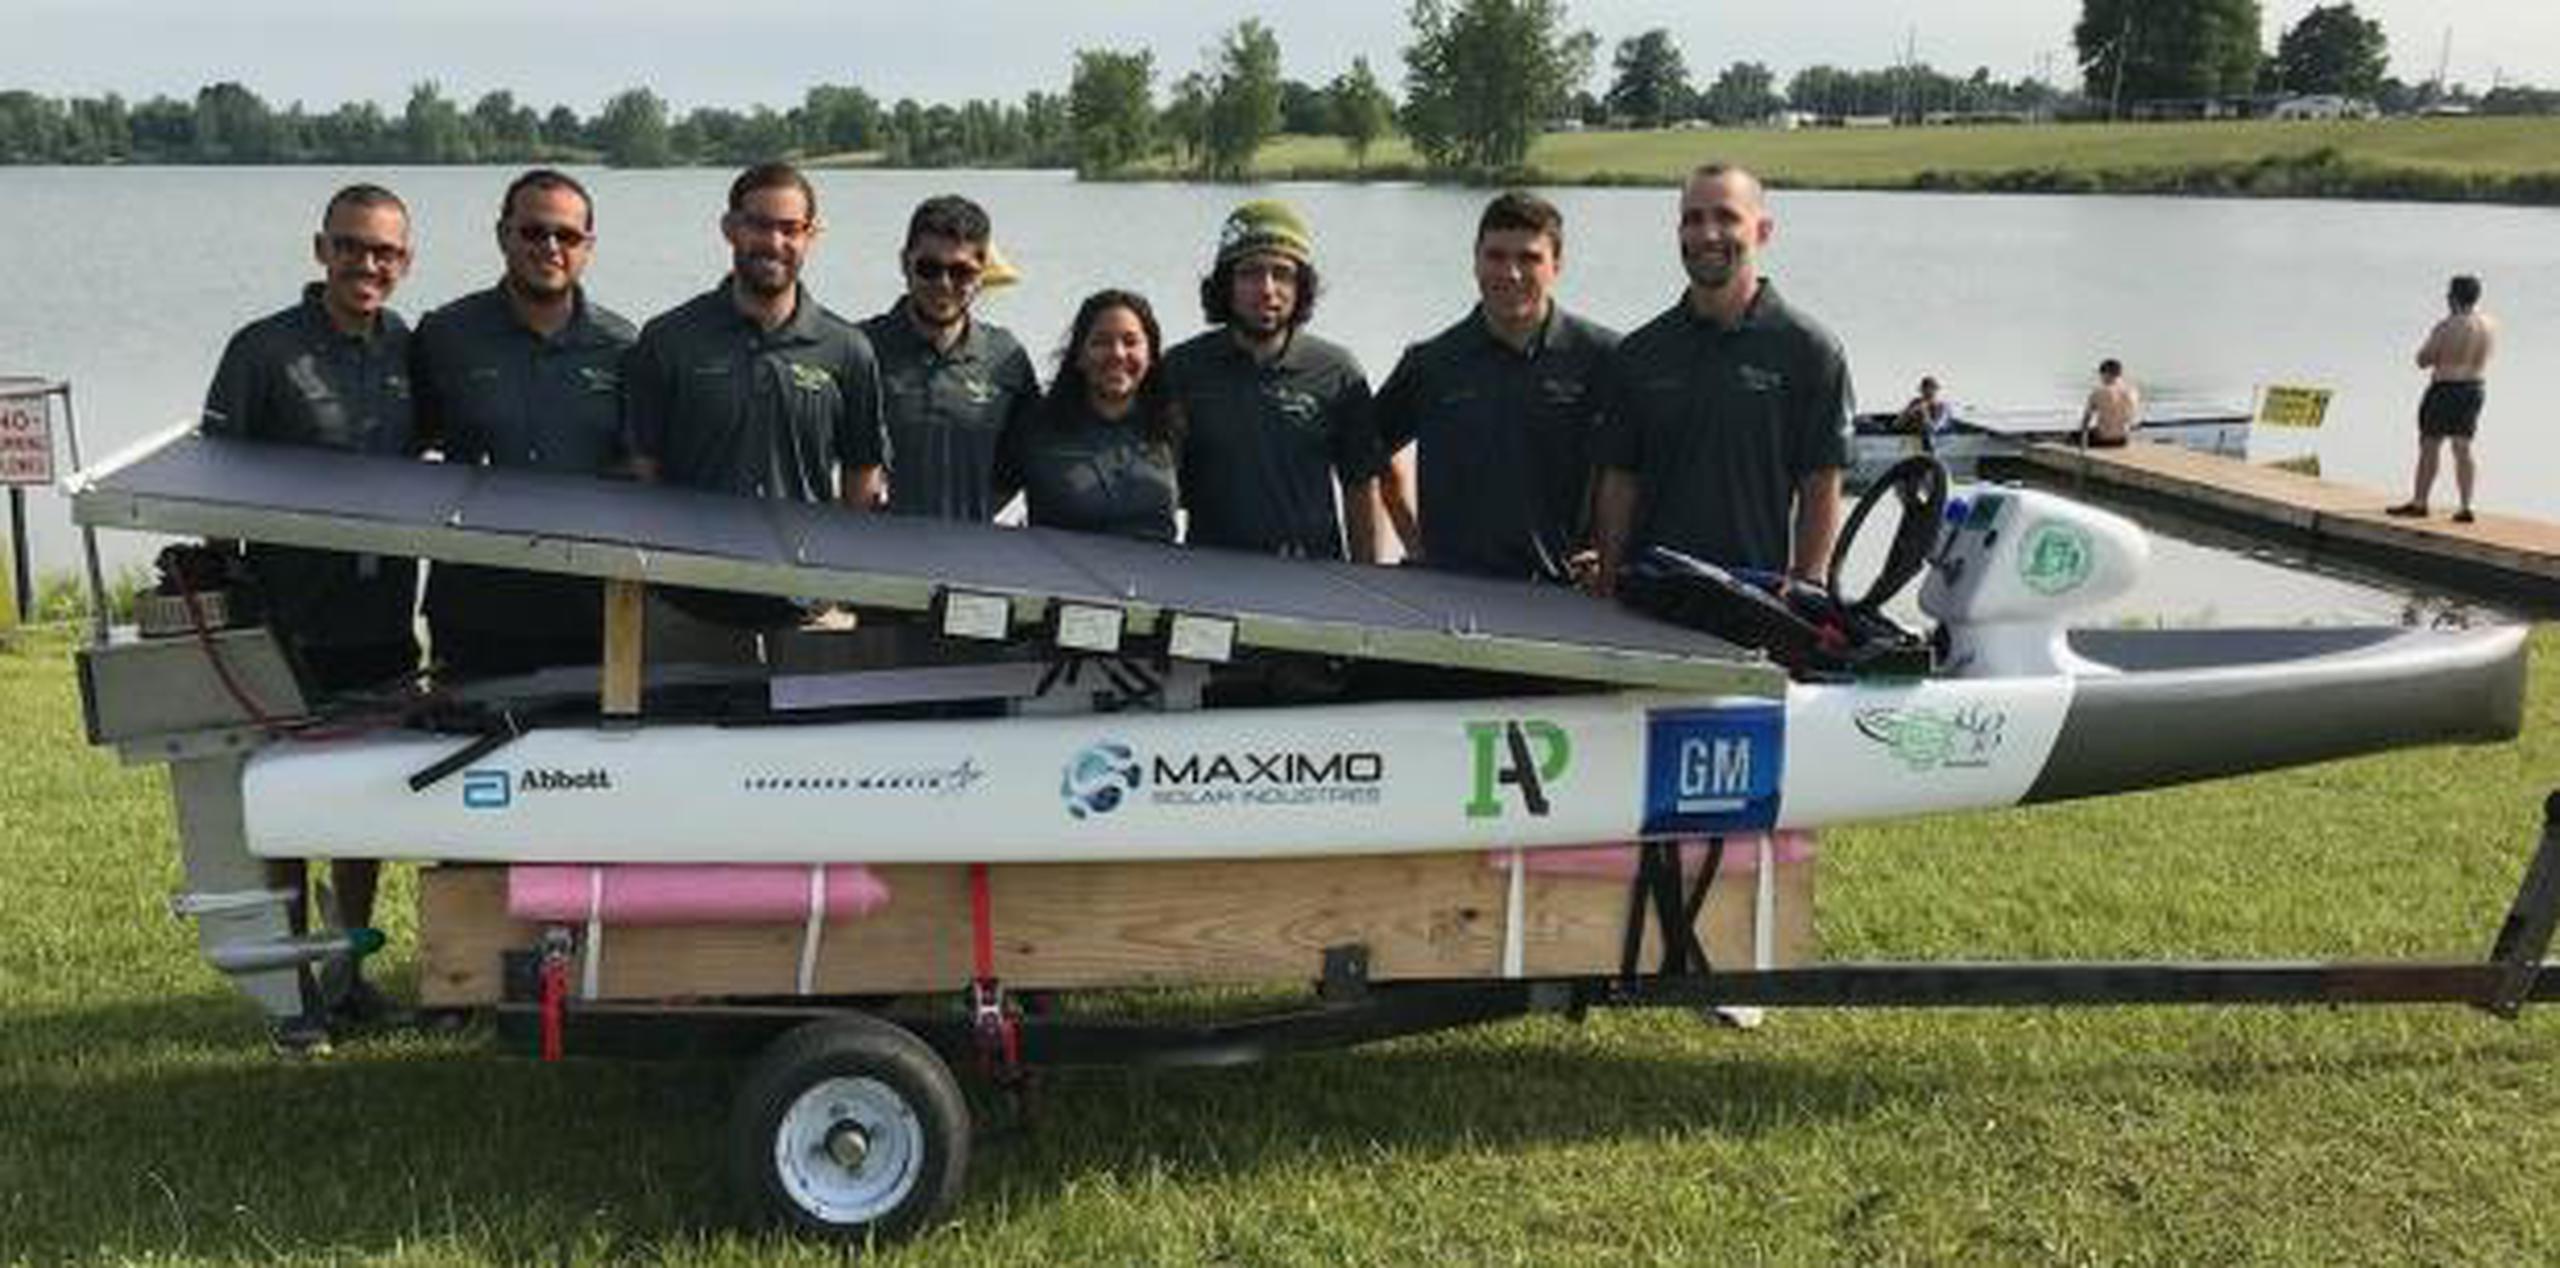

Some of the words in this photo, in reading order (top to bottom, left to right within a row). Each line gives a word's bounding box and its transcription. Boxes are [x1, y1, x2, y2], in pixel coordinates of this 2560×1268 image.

[519, 767, 612, 791] Abbott
[1153, 752, 1383, 784] MAXIMO
[1679, 737, 1750, 796] GM
[1152, 787, 1233, 804] SOLAR
[1239, 786, 1382, 804] INDUSTRIES
